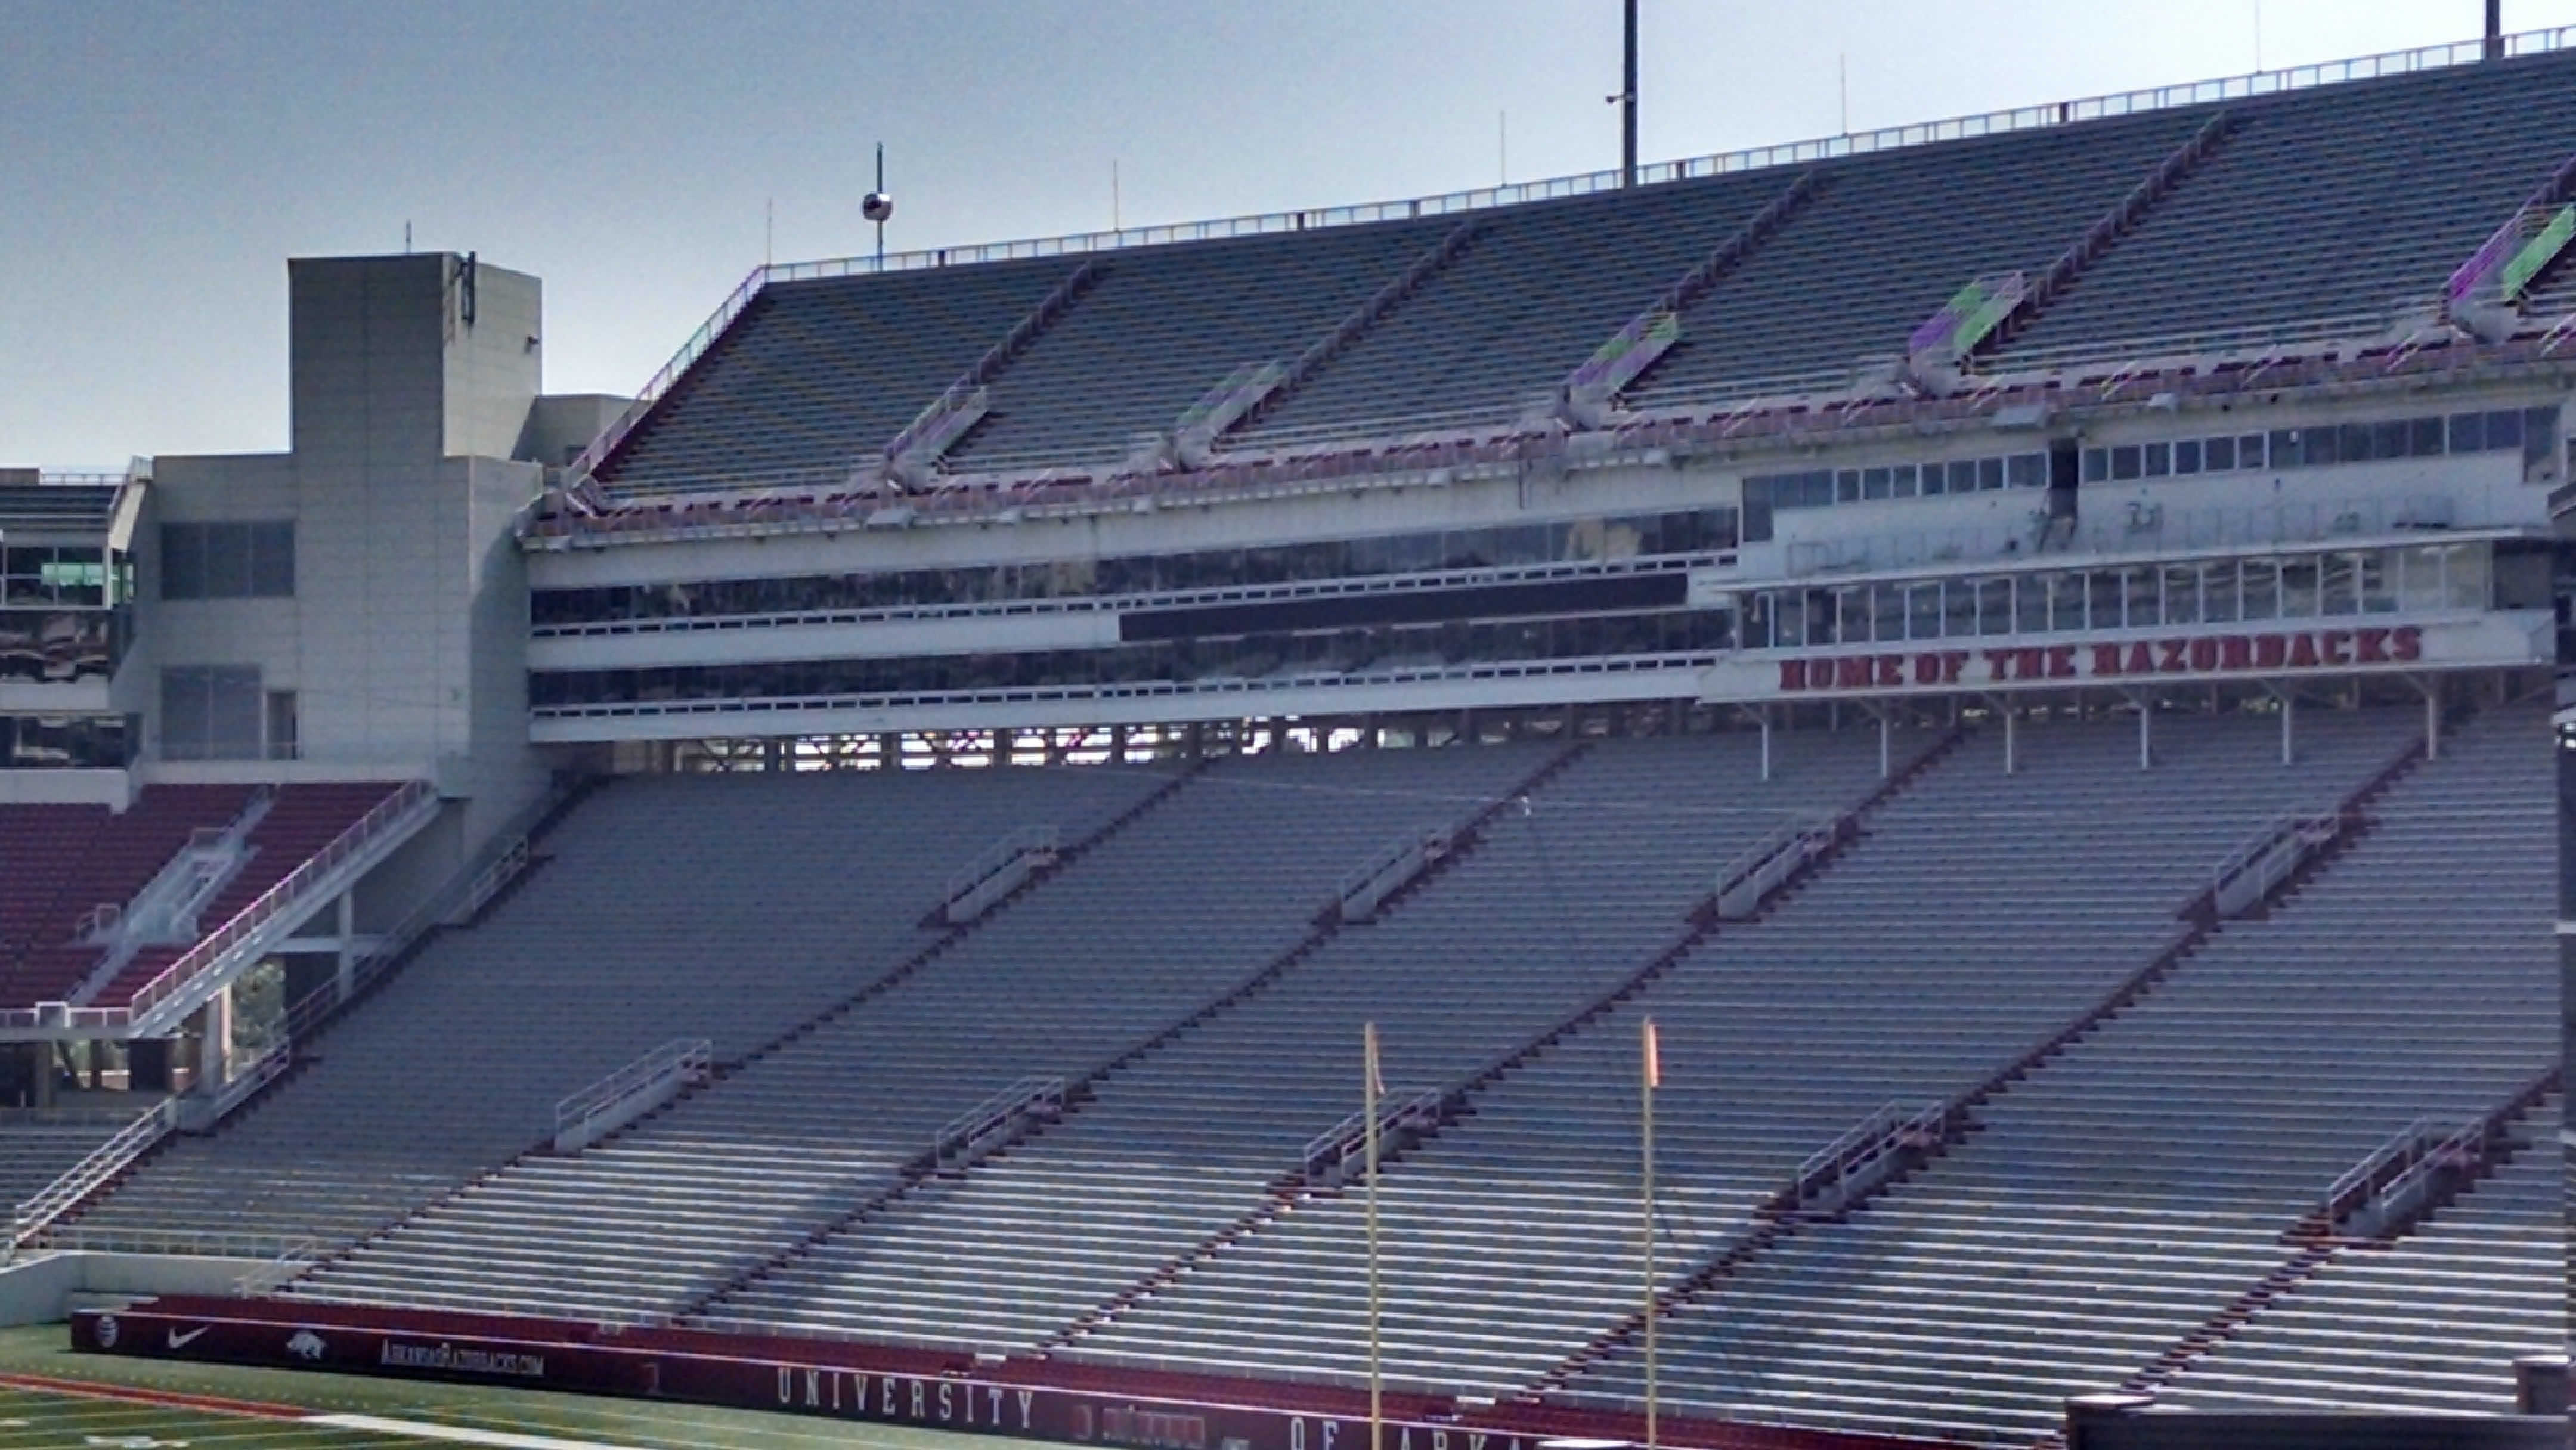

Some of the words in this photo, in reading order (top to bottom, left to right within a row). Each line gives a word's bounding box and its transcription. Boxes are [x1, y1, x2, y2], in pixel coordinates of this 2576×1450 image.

[1779, 655, 1903, 690] HOME
[1915, 650, 1970, 685] OF
[1981, 646, 2077, 681] THE
[2092, 625, 2423, 676] RAZORBACKS
[777, 1368, 1035, 1429] UNIVERSITY
[1289, 1416, 1339, 1450] OF
